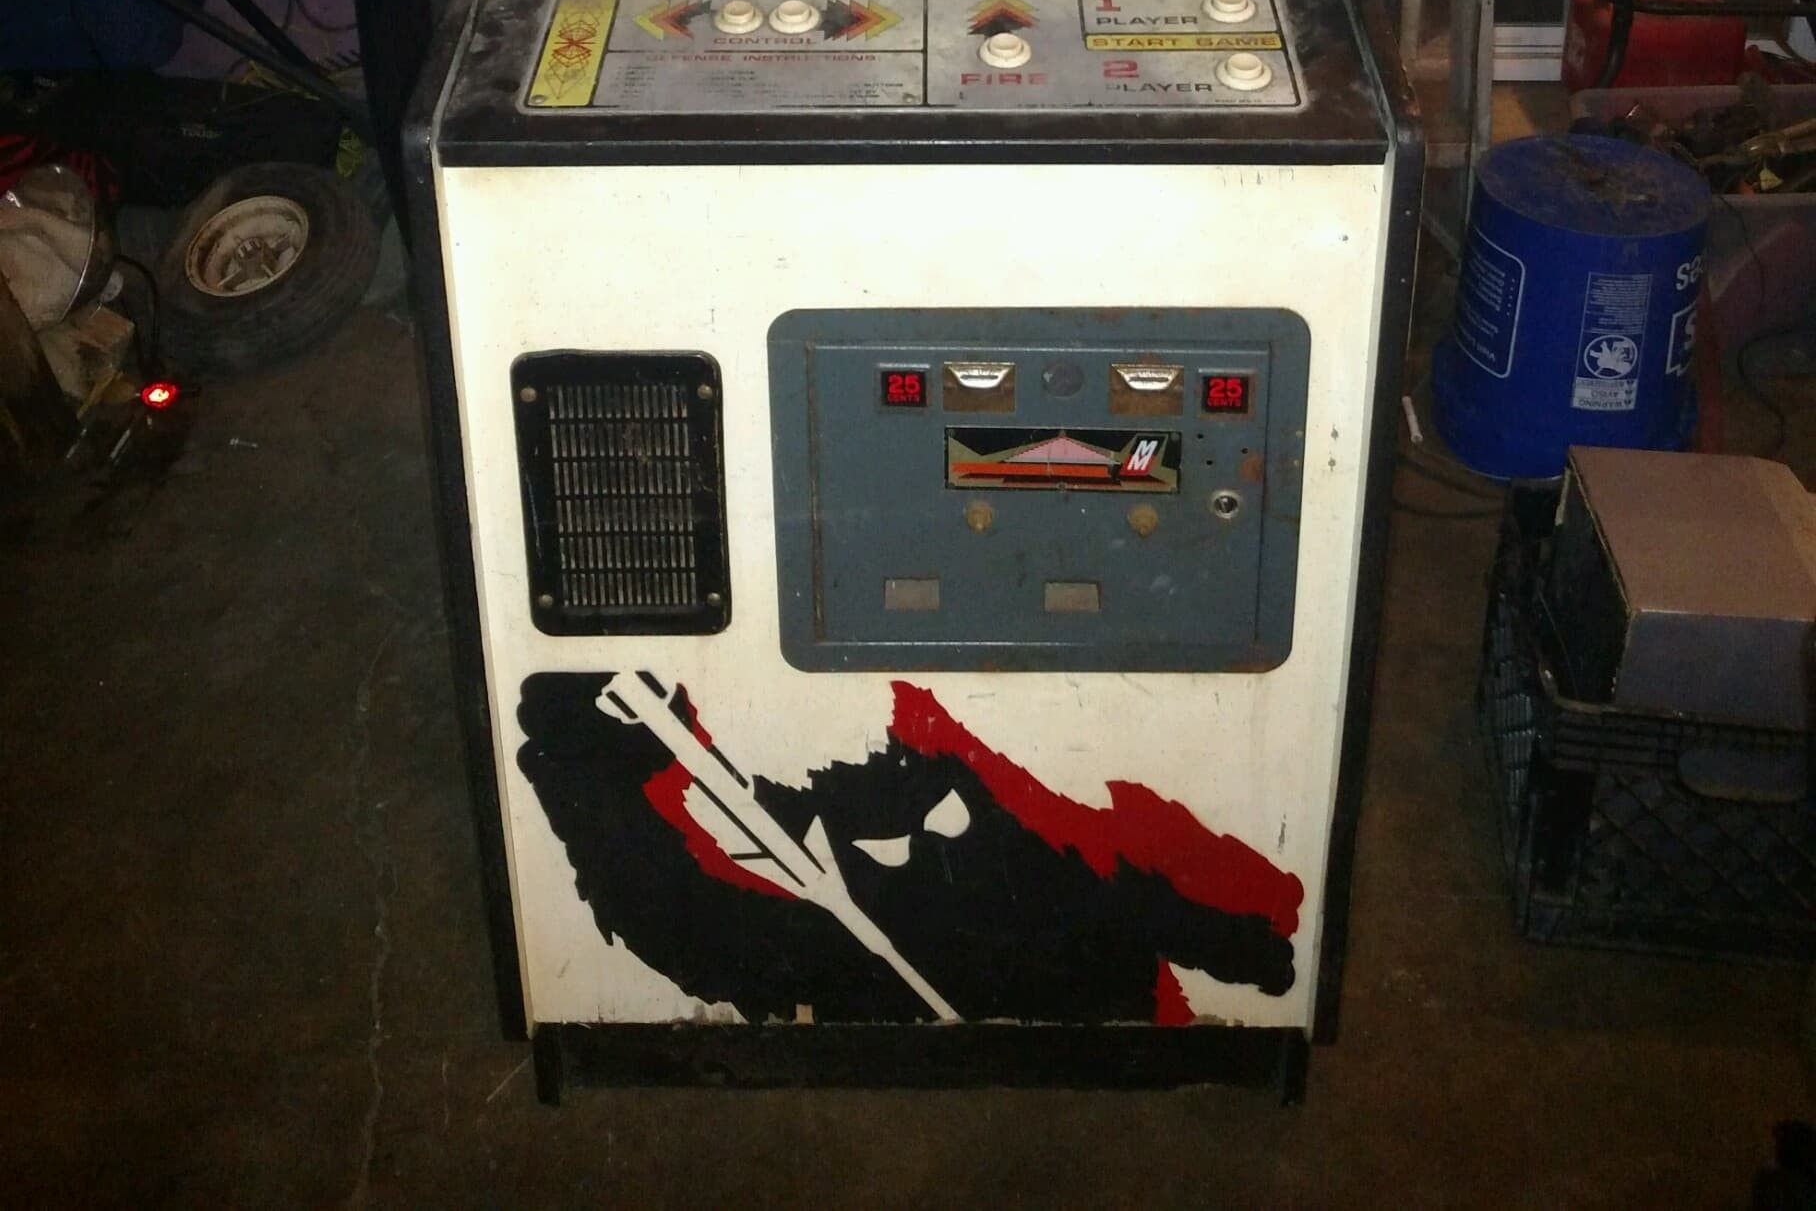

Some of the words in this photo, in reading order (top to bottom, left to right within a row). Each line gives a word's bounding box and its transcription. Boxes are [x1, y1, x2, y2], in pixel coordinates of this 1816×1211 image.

[1096, 16, 1200, 26] PLAYER
[713, 37, 817, 45] CONTROL
[1091, 38, 1178, 48] START
[1195, 37, 1279, 47] GAME
[743, 53, 877, 63] INSTRUTIONS
[1102, 59, 1140, 79] 2
[960, 73, 1049, 86] FIRE
[887, 374, 921, 394] 25
[1208, 377, 1243, 398] 25
